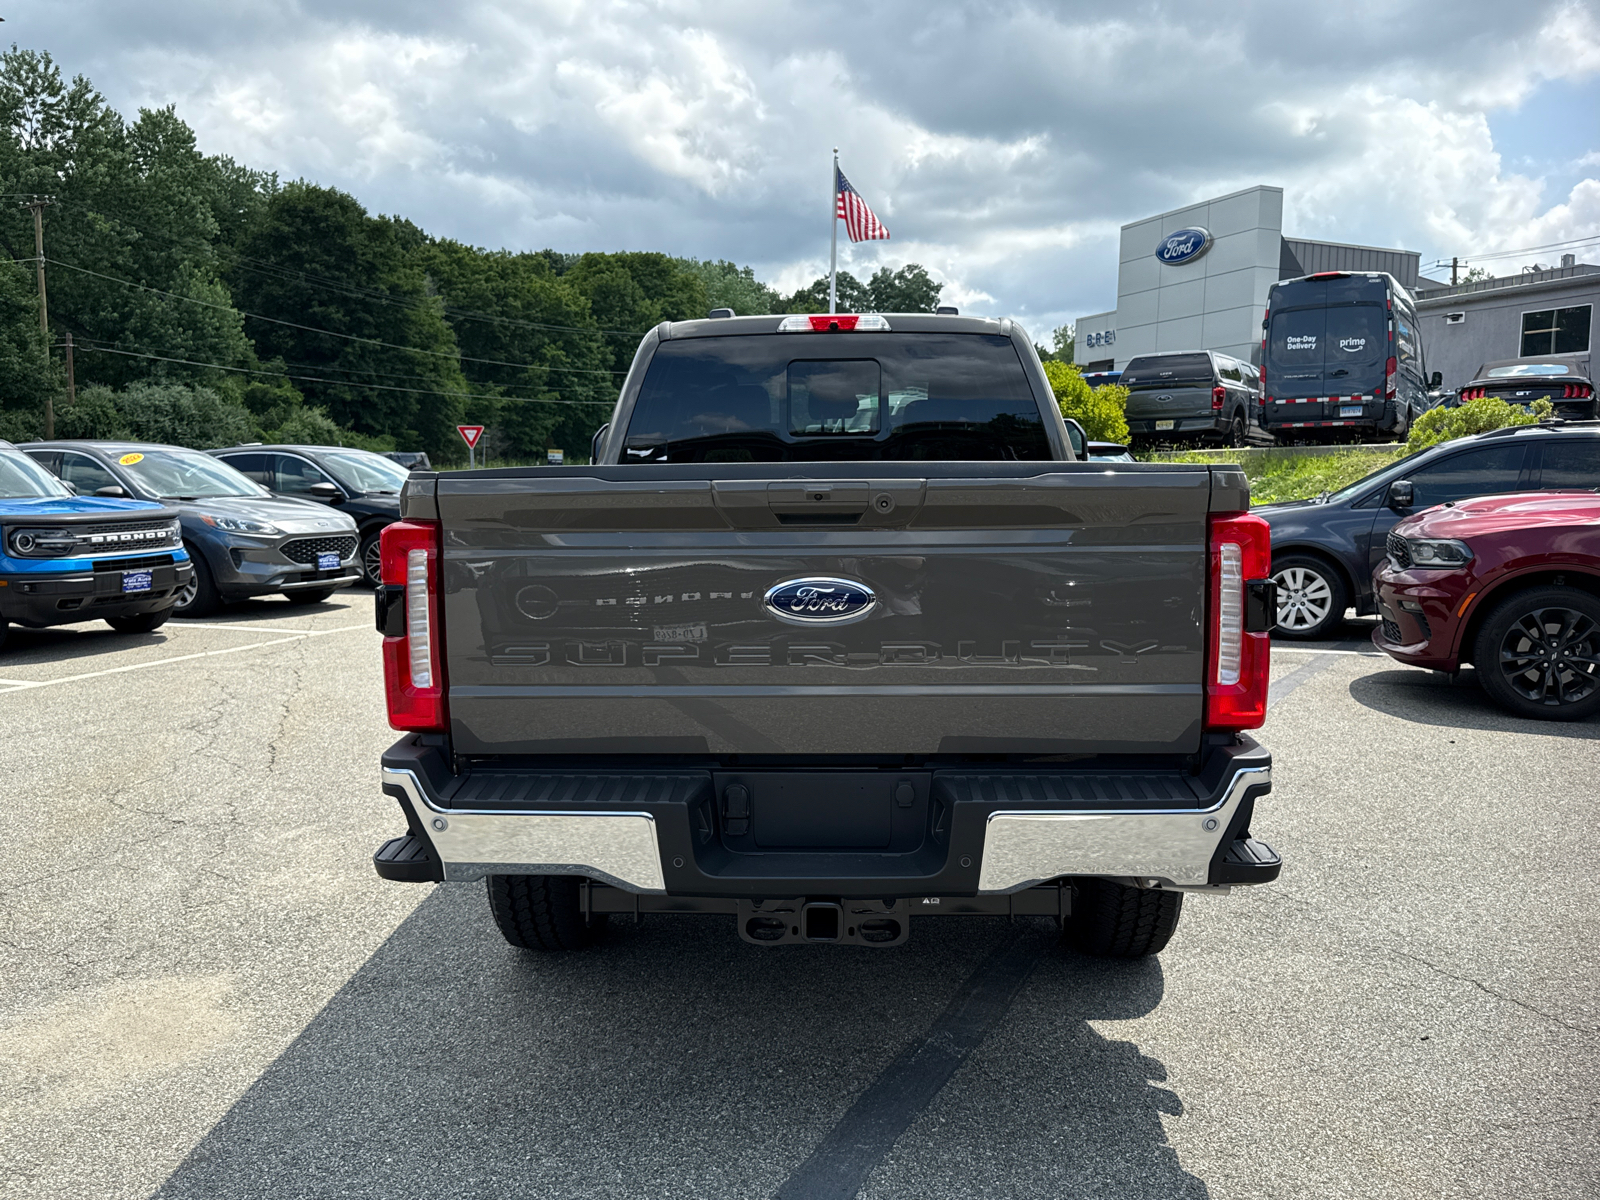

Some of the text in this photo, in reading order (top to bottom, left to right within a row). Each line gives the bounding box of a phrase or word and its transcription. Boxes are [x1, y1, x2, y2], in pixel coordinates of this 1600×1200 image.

[1163, 234, 1195, 259] Ford
[1286, 335, 1317, 343] One-Day
[1340, 337, 1366, 348] prime
[1286, 342, 1317, 350] Delivery
[91, 531, 167, 543] BRONCO
[790, 586, 850, 612] Ford
[490, 638, 1160, 667] SUPER DUTY
